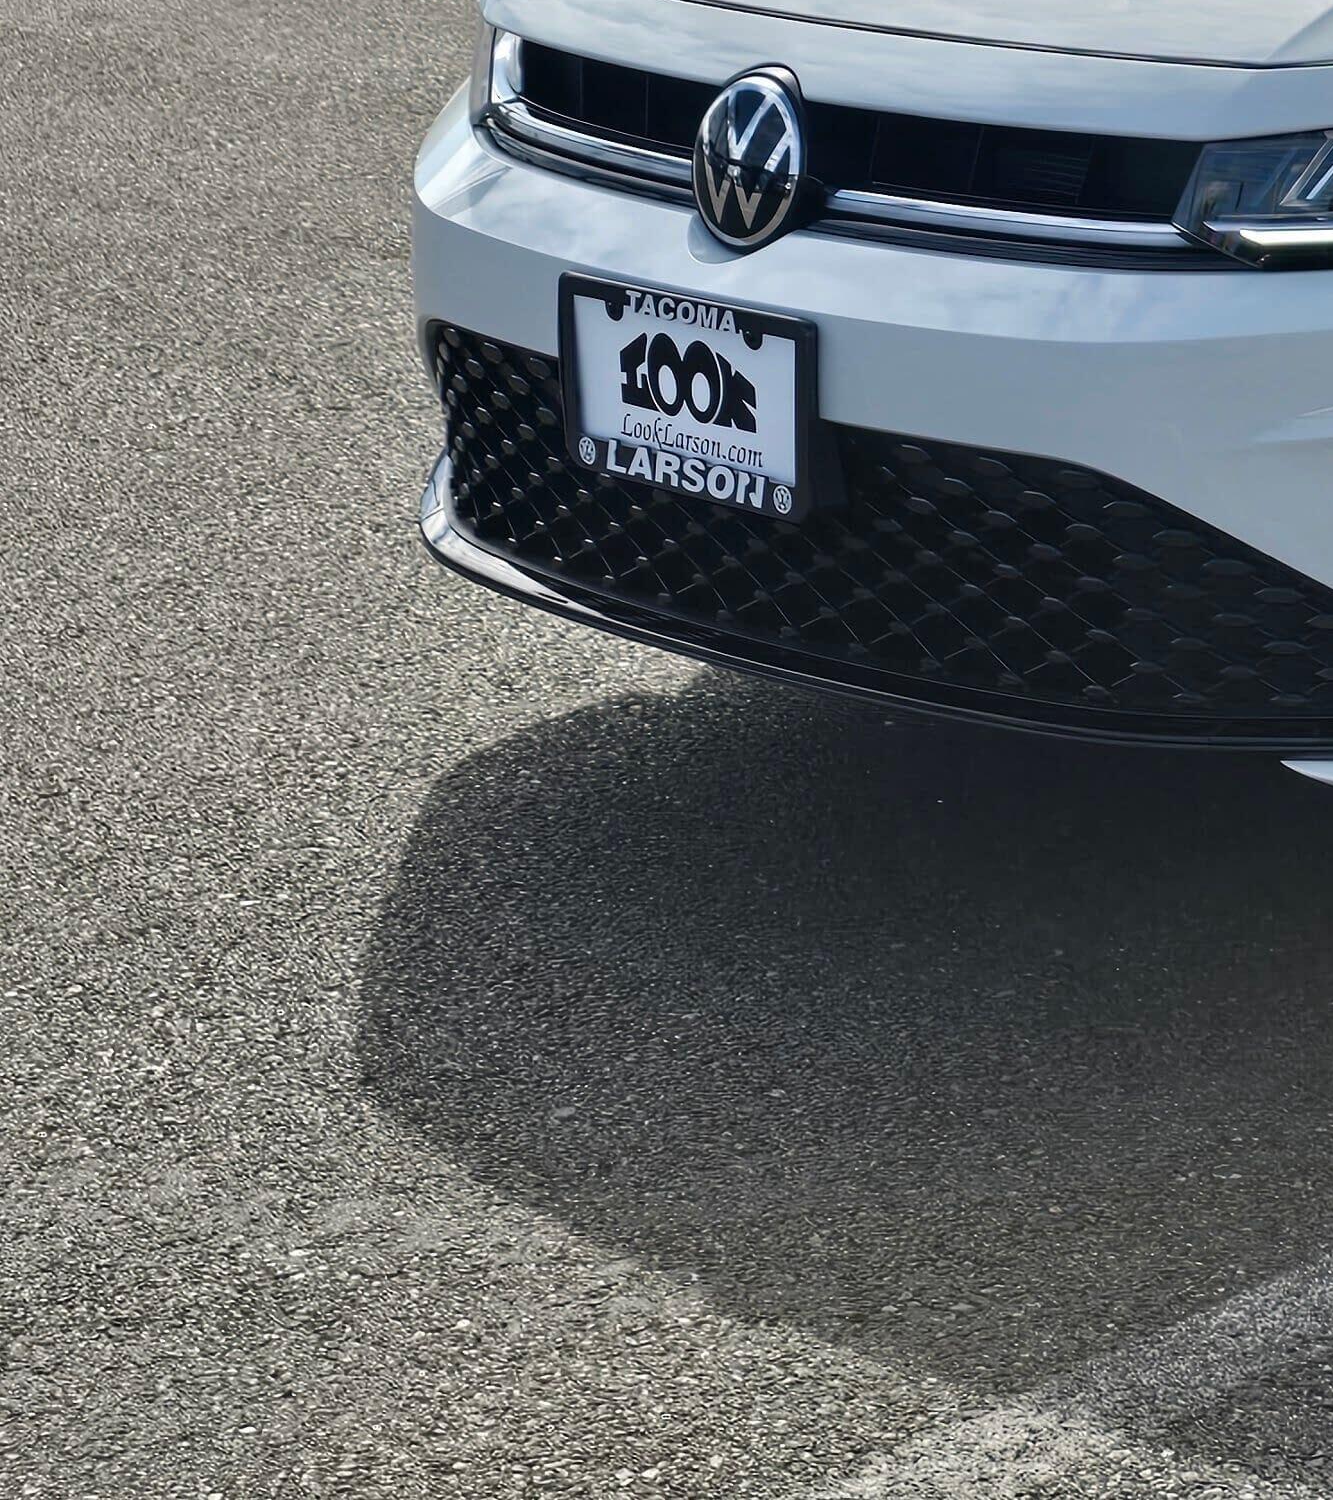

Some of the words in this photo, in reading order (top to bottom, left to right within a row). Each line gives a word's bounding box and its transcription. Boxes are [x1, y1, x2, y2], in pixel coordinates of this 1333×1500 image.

[626, 290, 737, 334] TACOMA
[621, 413, 763, 468] LookLarson.com
[606, 438, 767, 509] LARSON
